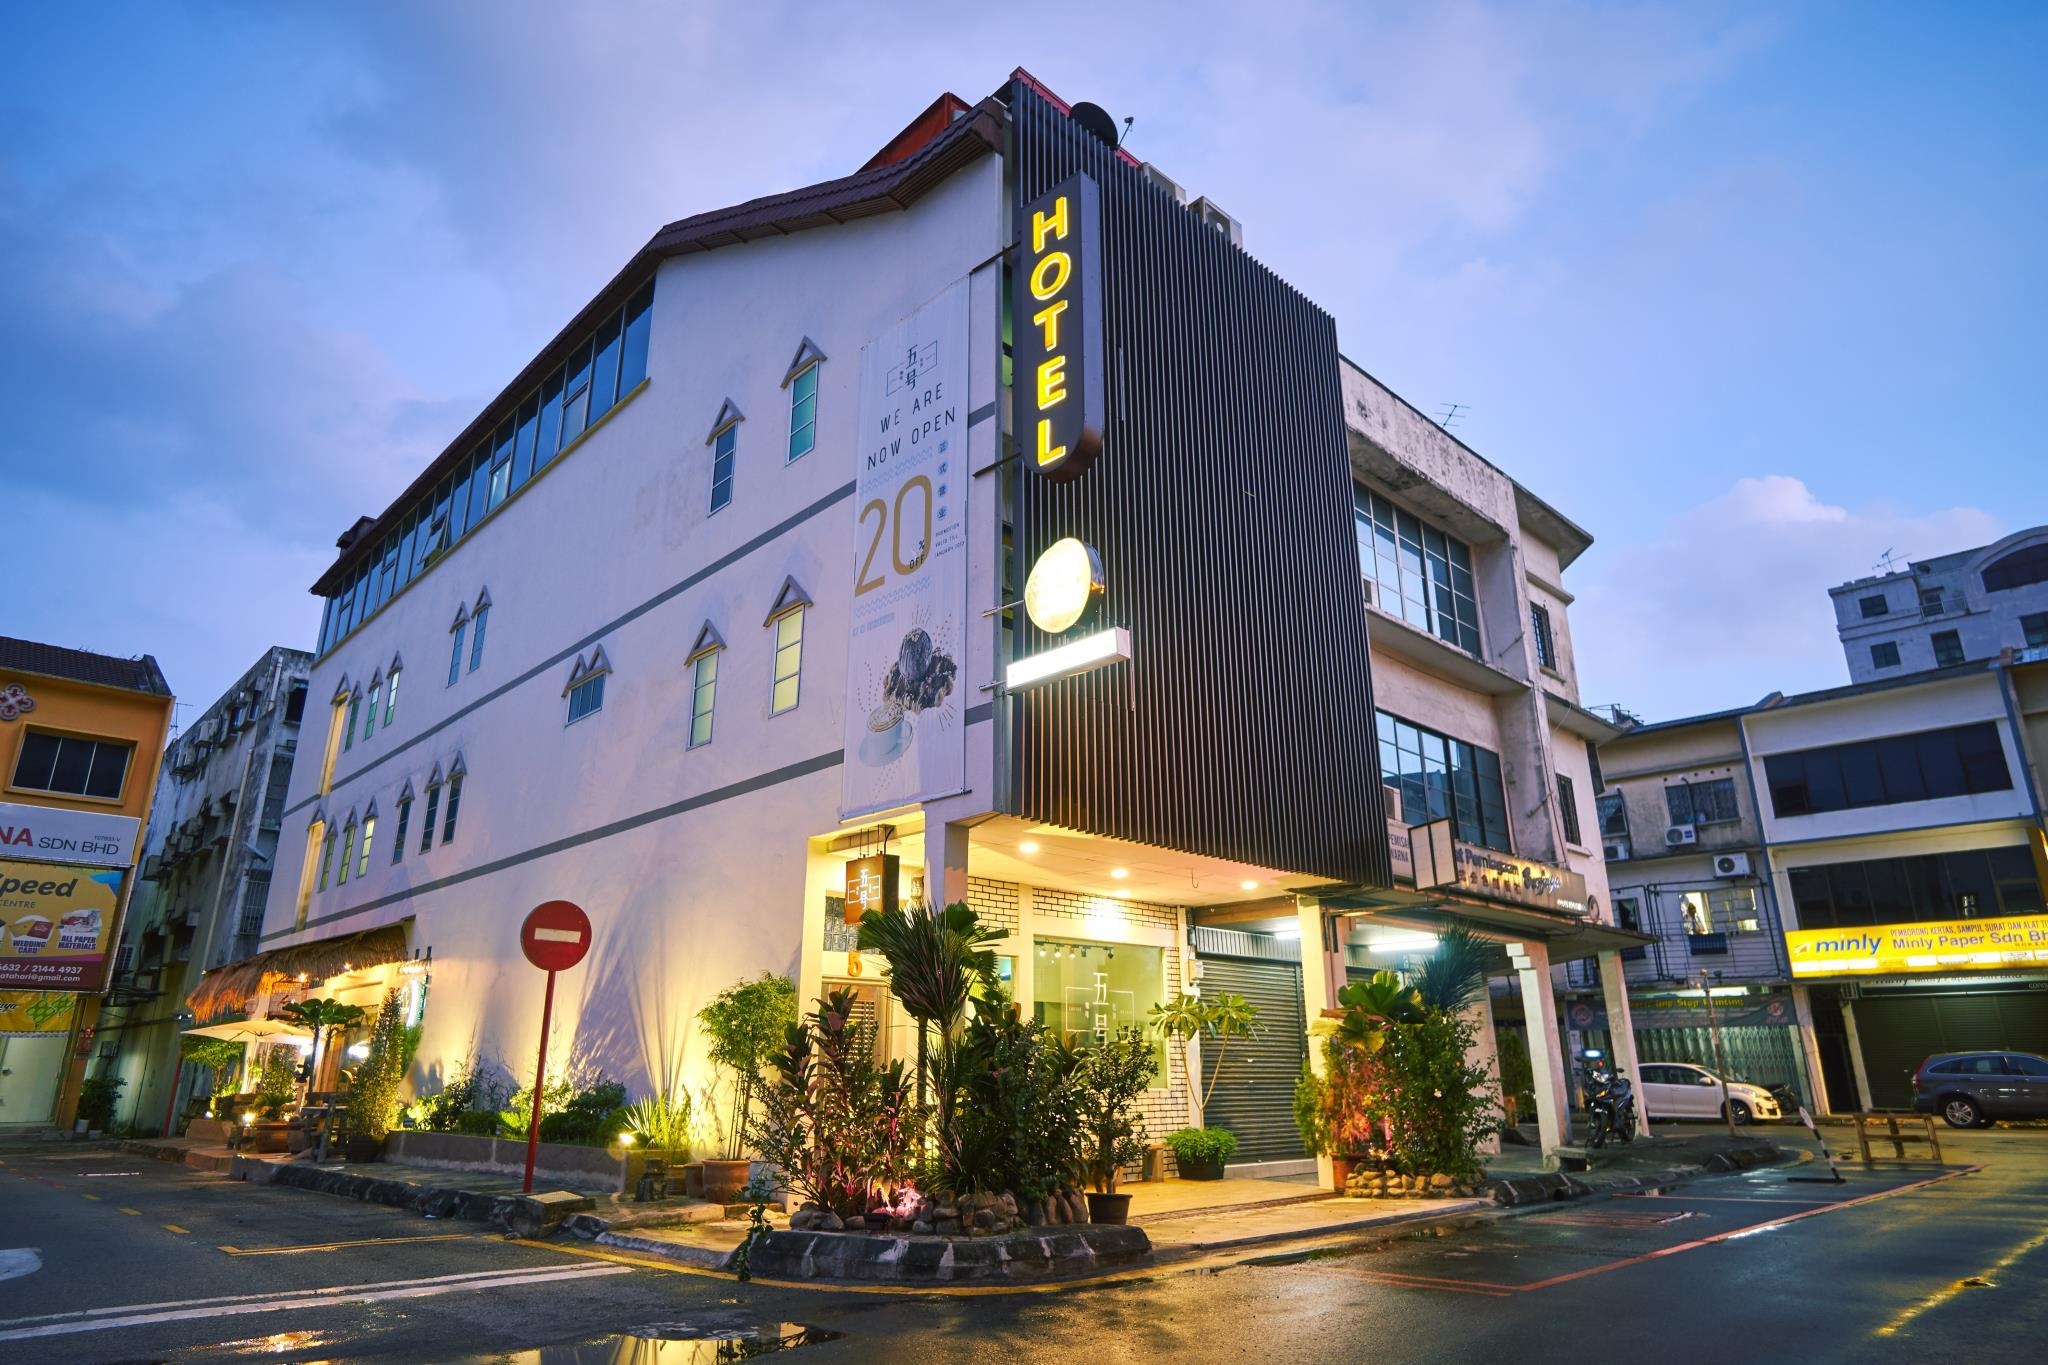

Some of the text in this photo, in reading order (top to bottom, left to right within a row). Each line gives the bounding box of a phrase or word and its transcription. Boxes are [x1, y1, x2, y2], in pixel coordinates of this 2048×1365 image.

[1030, 196, 1071, 467] HOTEL
[880, 382, 943, 433] WE ARE
[867, 406, 955, 471] NOW OPEN
[855, 474, 932, 597] 20
[909, 554, 925, 569] OFF
[39, 836, 77, 852] SDN
[81, 841, 119, 855] BHD
[0, 873, 78, 898] peed
[1958, 924, 1984, 933] SAMPUL
[1985, 922, 2005, 932] SURAT
[2008, 920, 2021, 930] DAN
[2024, 920, 2039, 929] ALAT
[13, 940, 47, 949] WEDDING
[58, 942, 96, 951] MATERIALS
[61, 935, 96, 944] ALL PAPER
[1816, 934, 1882, 955] minly
[1892, 938, 1933, 950] Minly
[1939, 934, 1985, 948] Paper
[1990, 932, 2023, 943] Sdn
[32, 965, 56, 973] 2144
[58, 966, 82, 974] 4937
